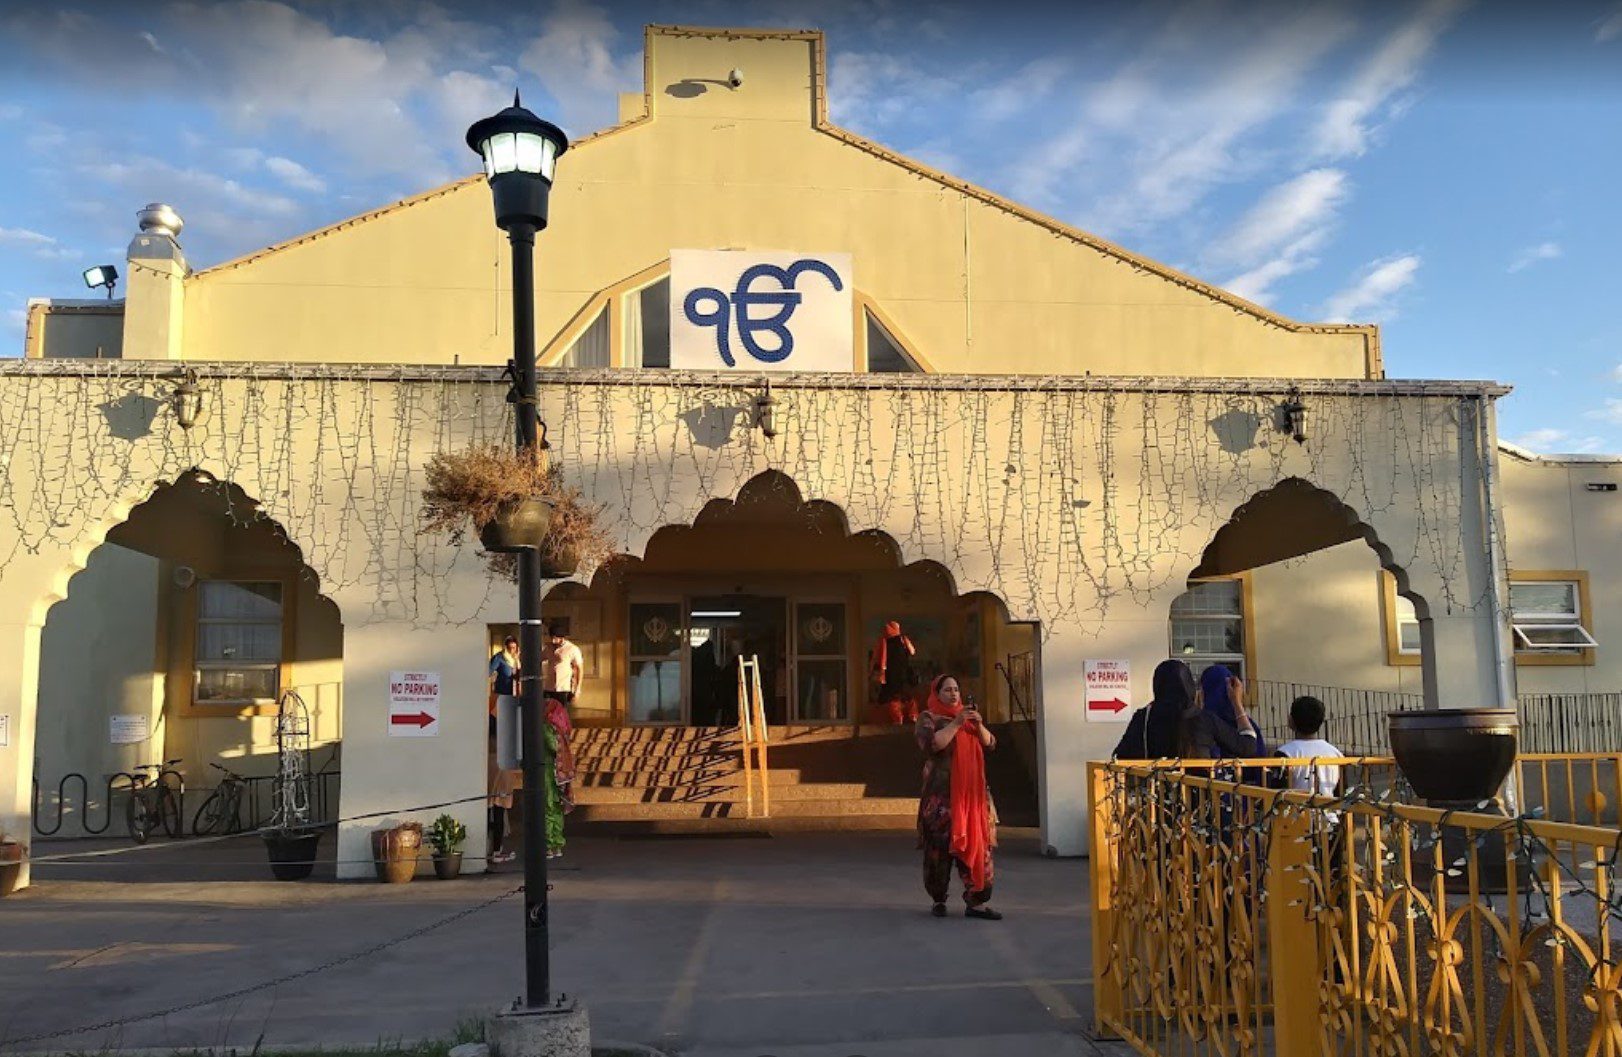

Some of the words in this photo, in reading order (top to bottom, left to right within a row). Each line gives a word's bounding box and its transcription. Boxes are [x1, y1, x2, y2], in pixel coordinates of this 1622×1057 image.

[1087, 671, 1096, 682] NO
[1098, 671, 1128, 682] PARKING
[391, 683, 402, 694] NO
[404, 683, 438, 695] PARKING
